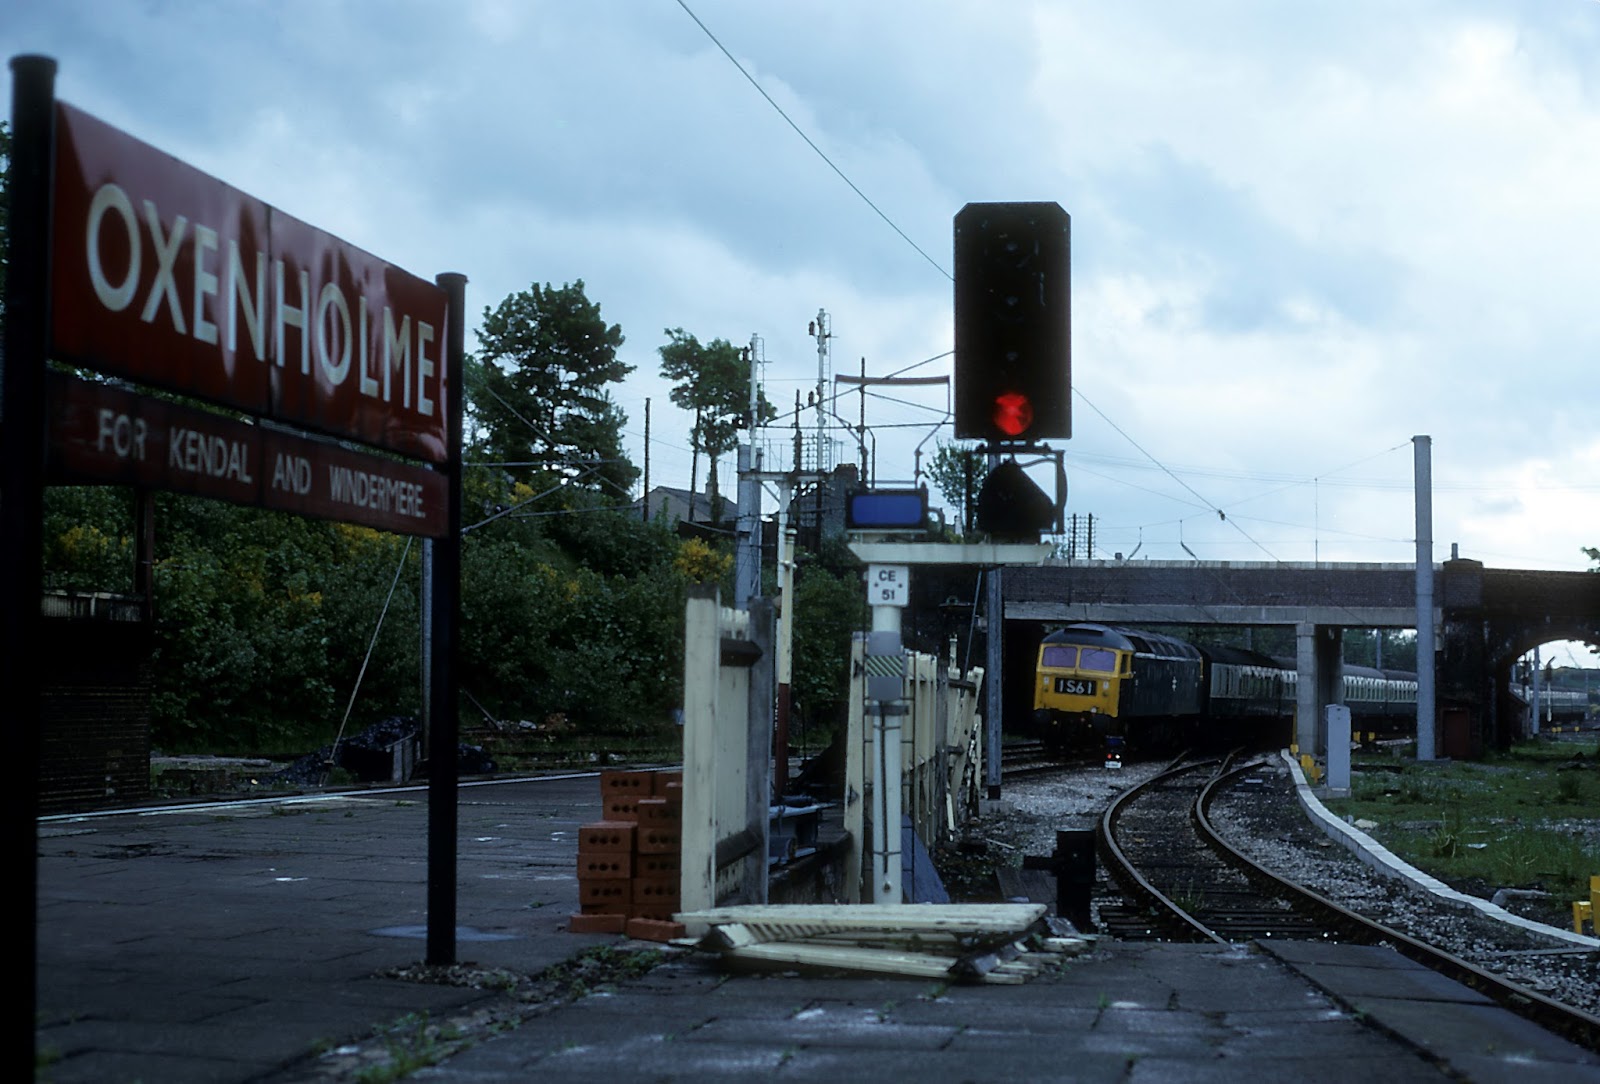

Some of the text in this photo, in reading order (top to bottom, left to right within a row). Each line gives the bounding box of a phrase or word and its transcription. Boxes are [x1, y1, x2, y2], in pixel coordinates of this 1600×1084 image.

[86, 183, 434, 416] OXENHOLME
[97, 408, 146, 461] FOR
[169, 426, 252, 484] KENDAL
[272, 453, 312, 495] AND
[878, 570, 896, 582] CE
[881, 589, 895, 600] 51
